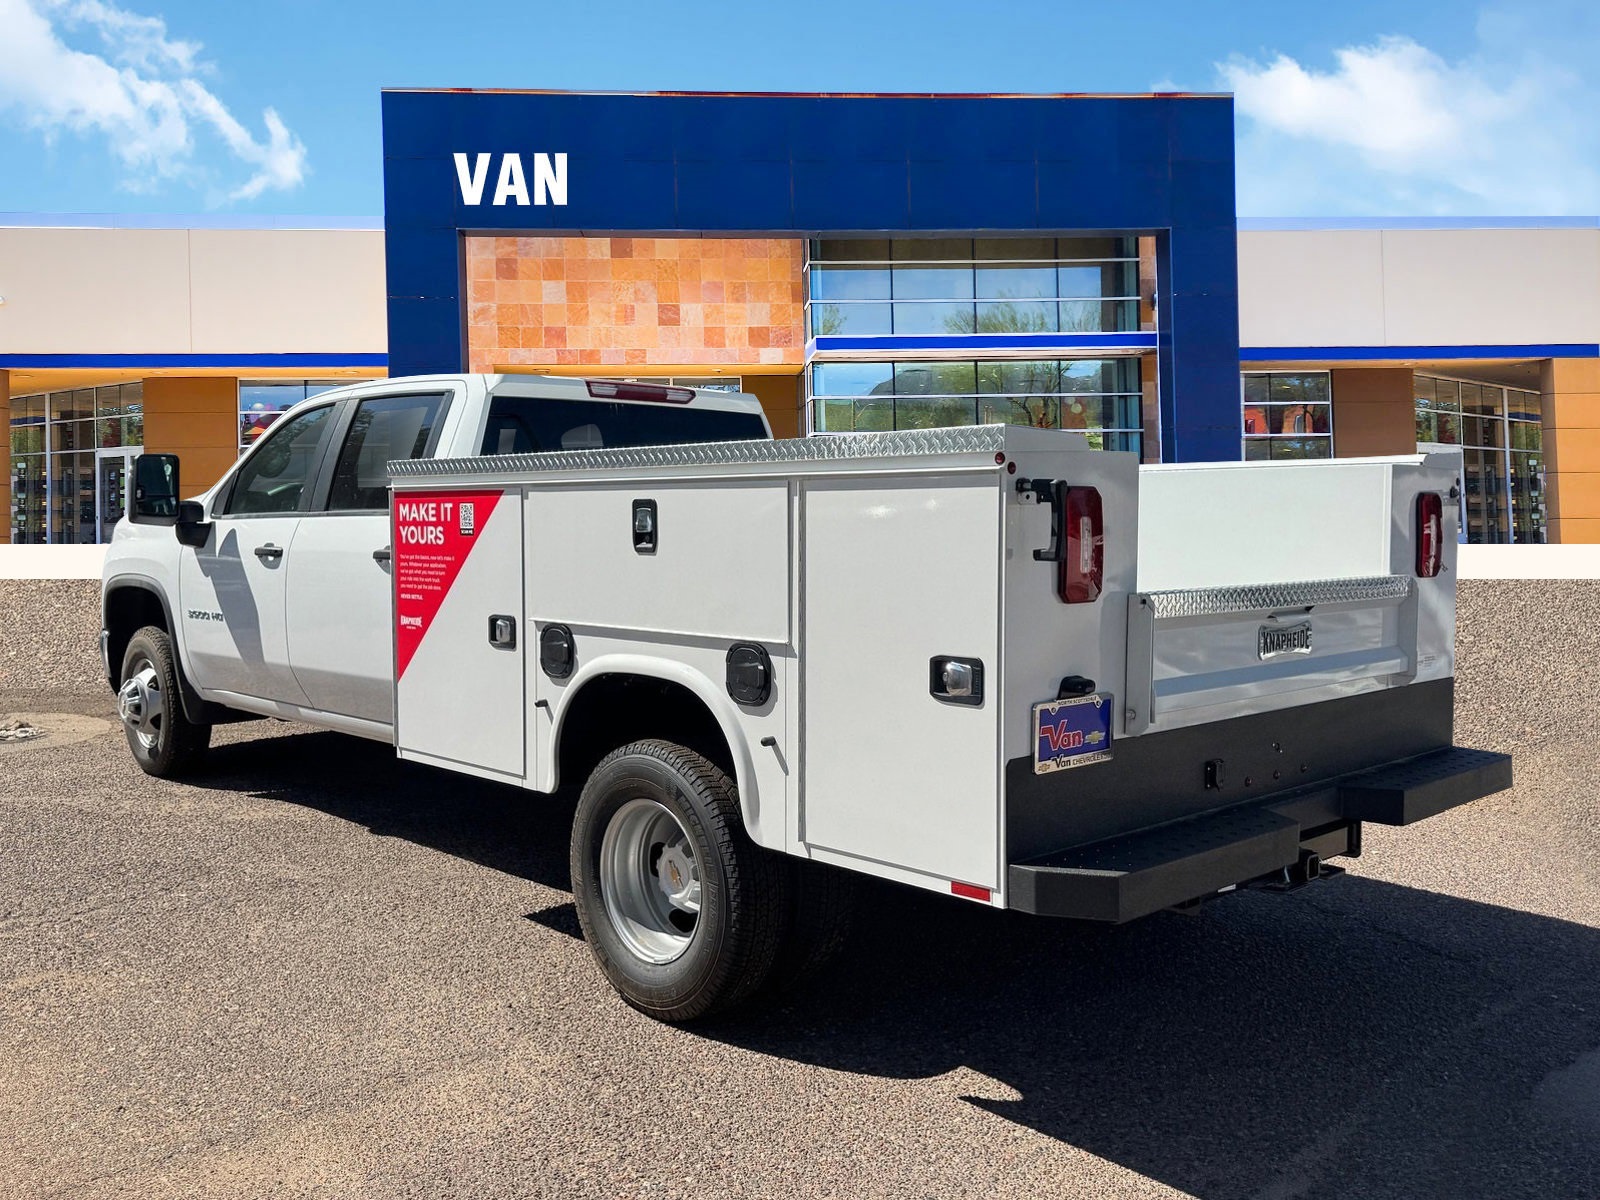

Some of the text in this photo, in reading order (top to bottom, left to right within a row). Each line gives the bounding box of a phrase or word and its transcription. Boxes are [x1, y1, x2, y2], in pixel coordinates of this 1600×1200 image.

[453, 153, 567, 205] VAN
[399, 503, 453, 521] MAKE IT
[399, 526, 444, 544] YOURS
[1262, 627, 1310, 655] KNAPHEIDE
[1040, 720, 1083, 751] Van
[1050, 754, 1071, 768] Van
